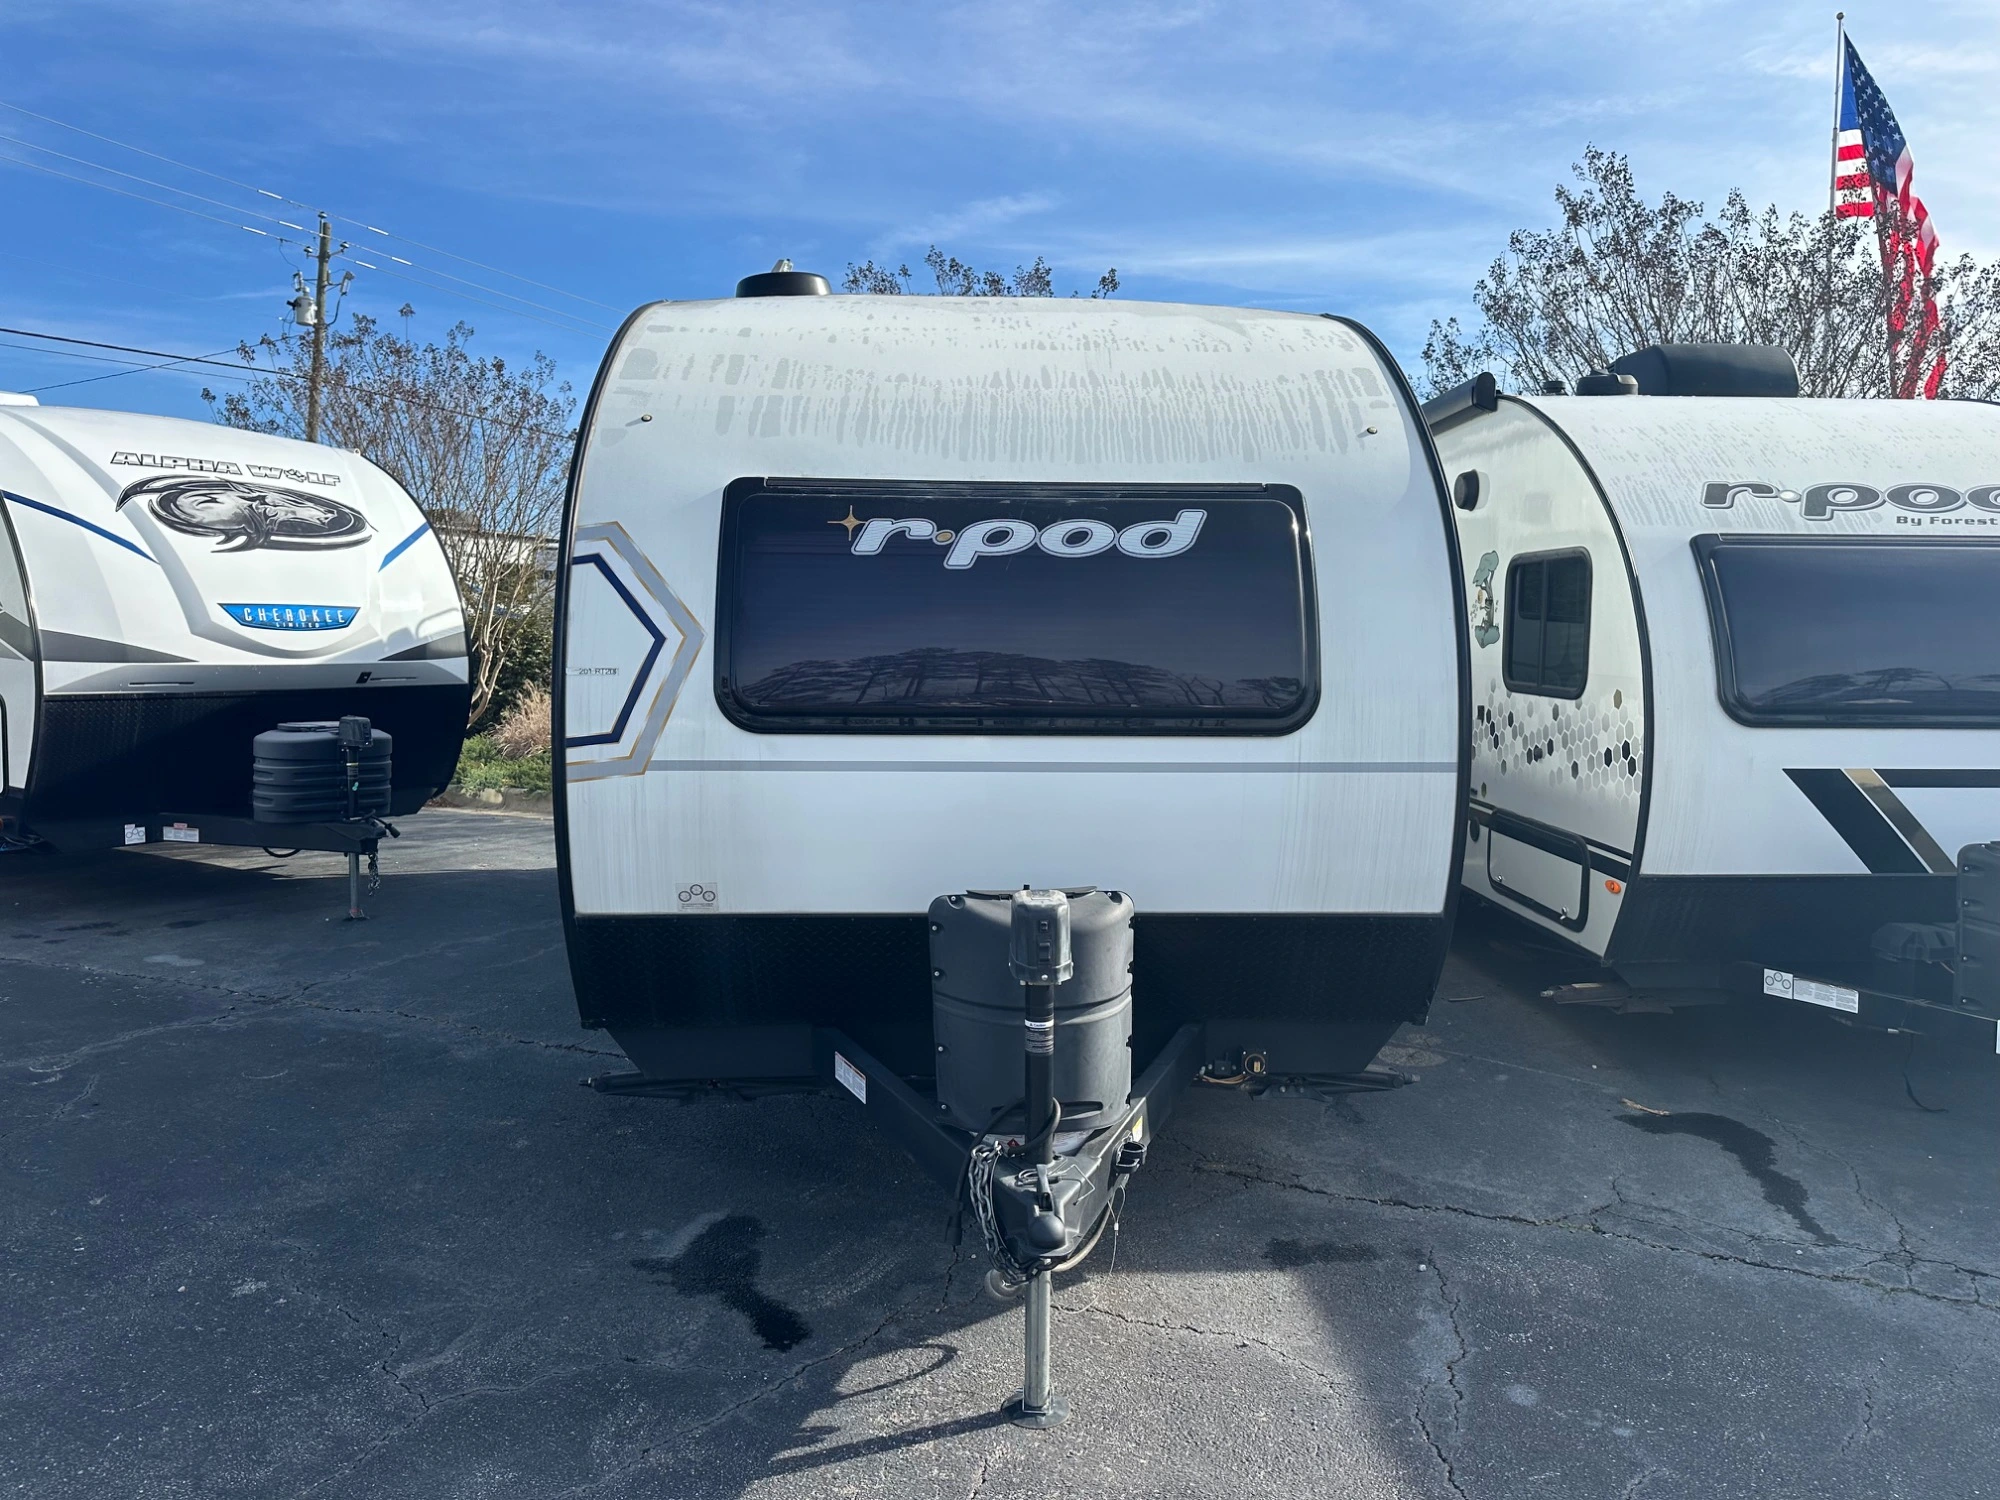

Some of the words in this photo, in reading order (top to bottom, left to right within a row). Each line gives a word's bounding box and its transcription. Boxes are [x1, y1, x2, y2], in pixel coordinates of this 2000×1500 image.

[110, 451, 243, 476] ALPHA
[1896, 515, 1922, 526] By
[1929, 516, 1998, 526] Forest
[243, 607, 346, 623] CHEROKEE
